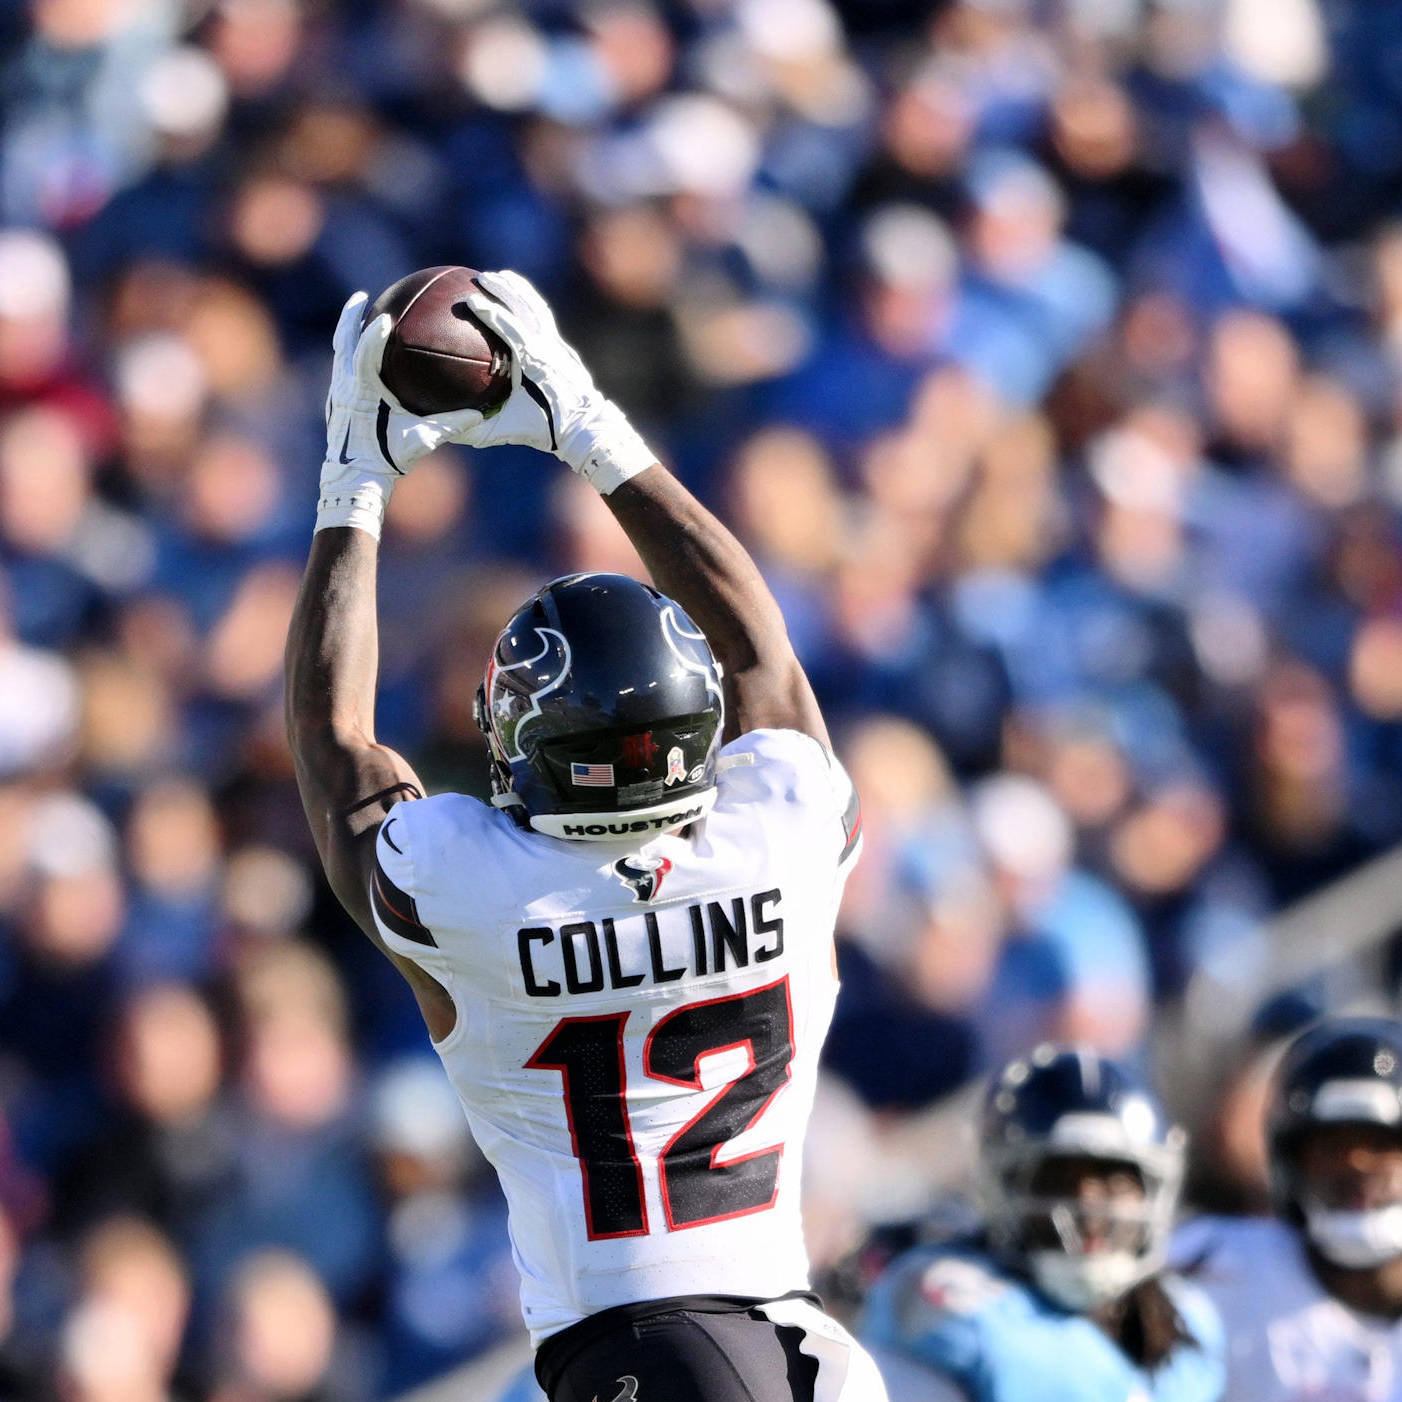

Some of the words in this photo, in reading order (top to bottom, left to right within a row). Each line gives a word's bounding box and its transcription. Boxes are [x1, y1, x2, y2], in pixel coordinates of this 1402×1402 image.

[562, 804, 703, 837] HOUSTON
[517, 887, 785, 998] COLLINS
[522, 973, 796, 1243] 12
